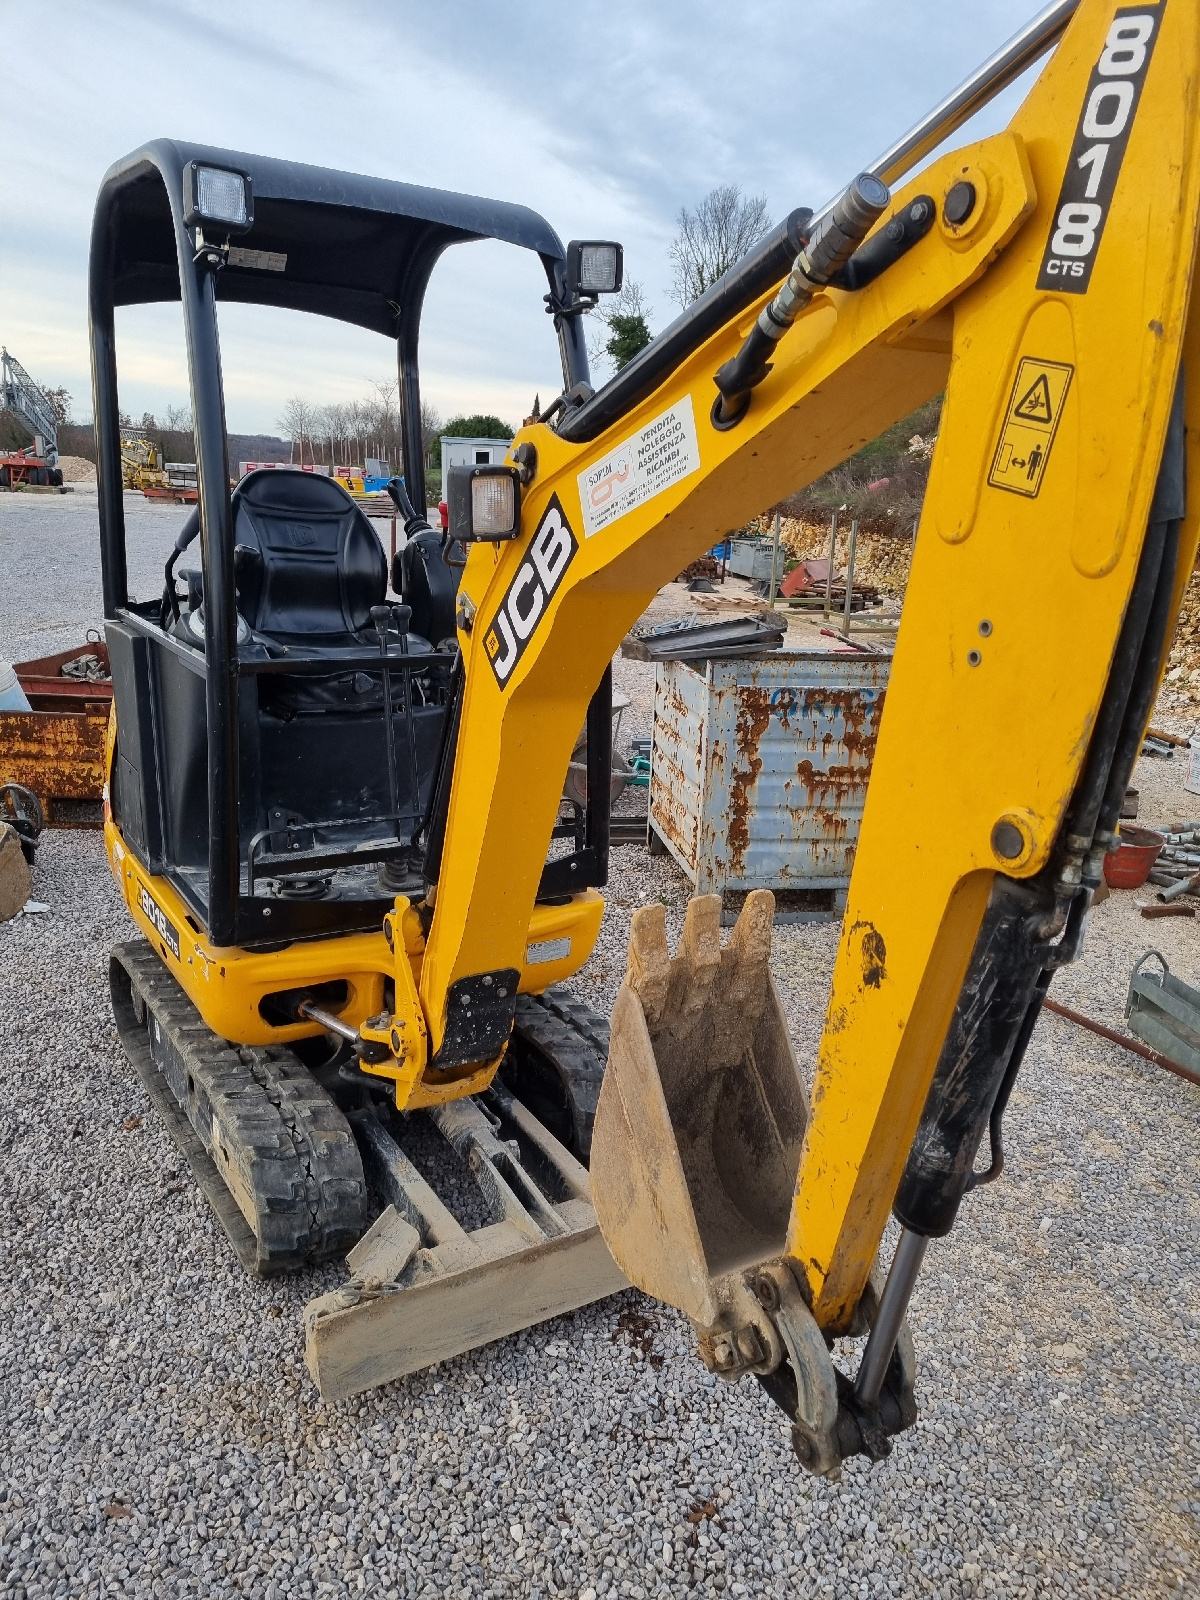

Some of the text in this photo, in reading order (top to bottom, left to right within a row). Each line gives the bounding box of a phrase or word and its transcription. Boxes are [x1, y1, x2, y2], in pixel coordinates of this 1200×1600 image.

[1051, 15, 1154, 257] 8018
[1046, 259, 1085, 277] CTS
[637, 421, 682, 458] NOLEGGIO
[640, 413, 676, 443] VENDITA
[637, 433, 686, 470] ASSISTENZA
[646, 448, 680, 477] RICAMBI
[494, 508, 572, 680] JCB
